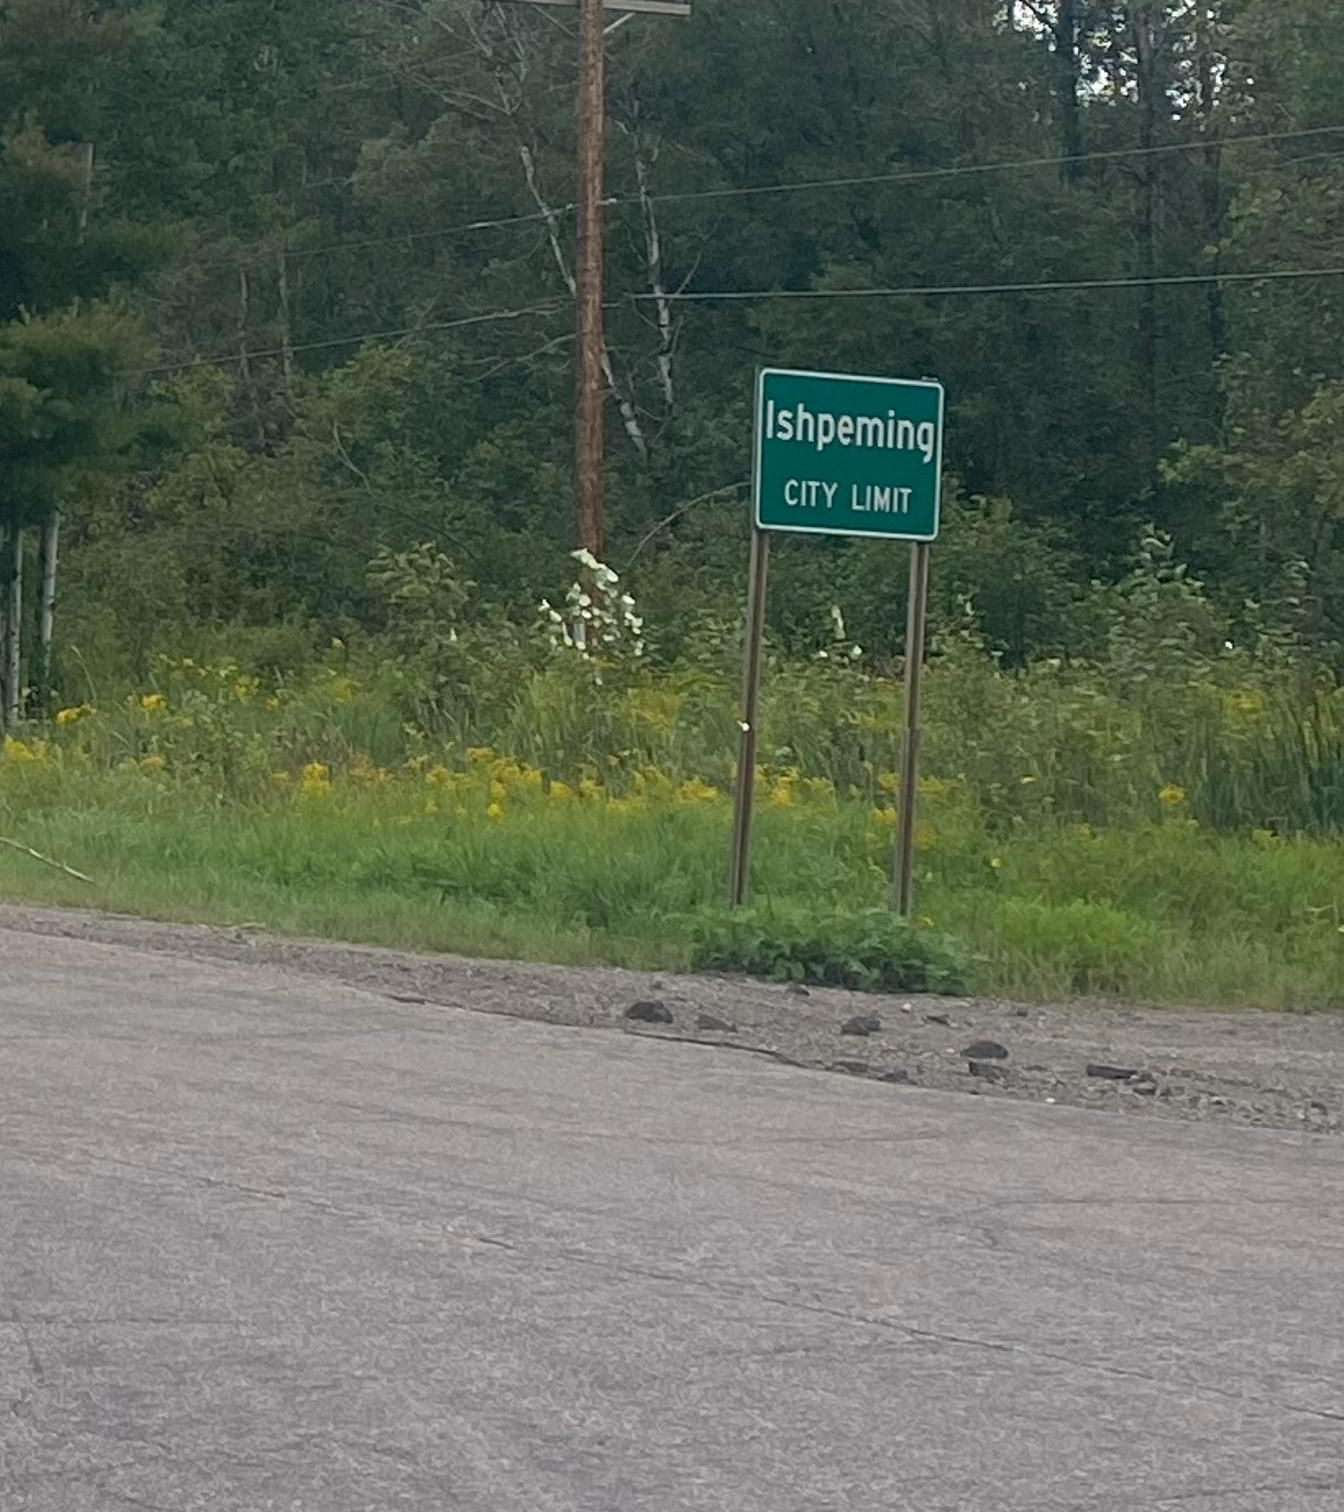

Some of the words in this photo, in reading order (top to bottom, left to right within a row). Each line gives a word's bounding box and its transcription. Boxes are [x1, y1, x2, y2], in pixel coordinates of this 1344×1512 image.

[766, 399, 934, 464] Ishpeming
[784, 479, 838, 508] CITY
[851, 484, 912, 514] LIMIT
